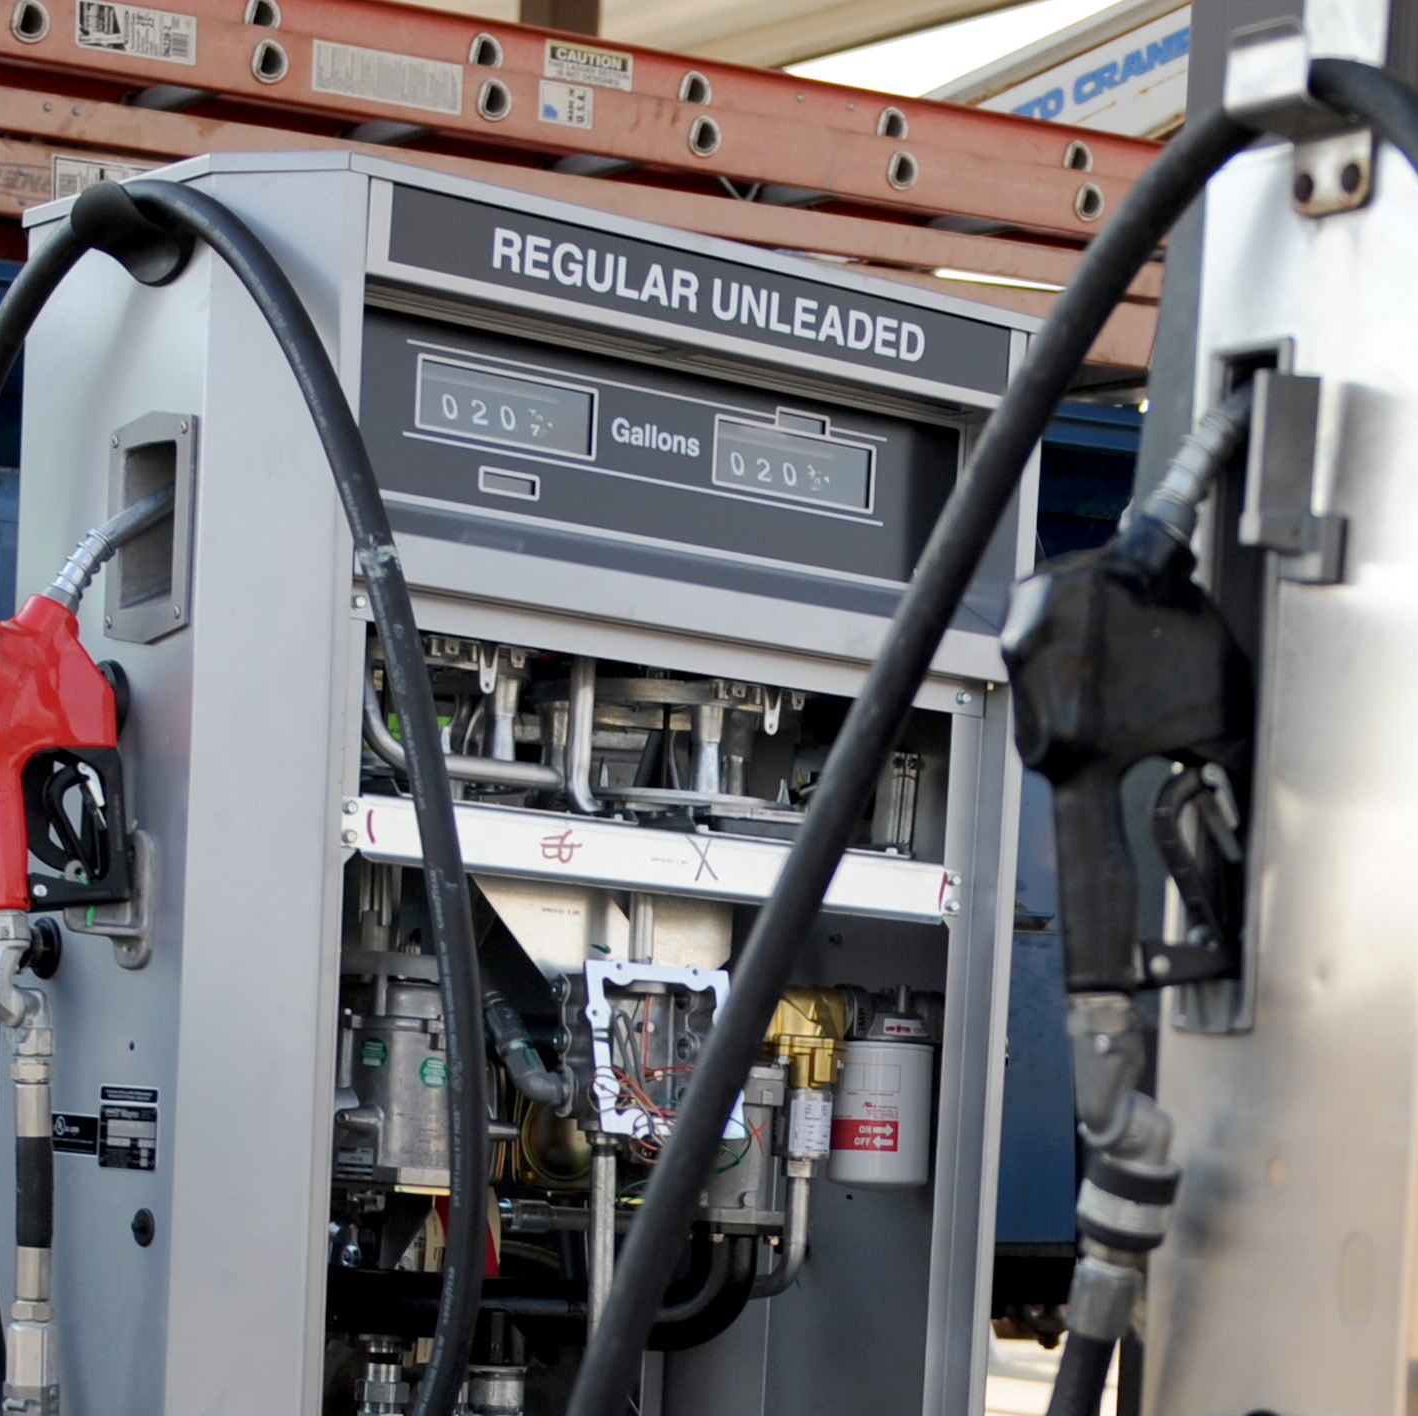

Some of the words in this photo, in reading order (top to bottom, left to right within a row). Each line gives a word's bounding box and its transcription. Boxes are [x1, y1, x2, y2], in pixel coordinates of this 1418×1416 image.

[555, 48, 623, 70] CAUTION
[1074, 24, 1192, 105] CRANE
[492, 227, 699, 313] REGULAR
[712, 282, 926, 362] UNLEADED
[612, 417, 701, 458] Gallons
[854, 1137, 872, 1146] OFF
[858, 1125, 872, 1134] ON
